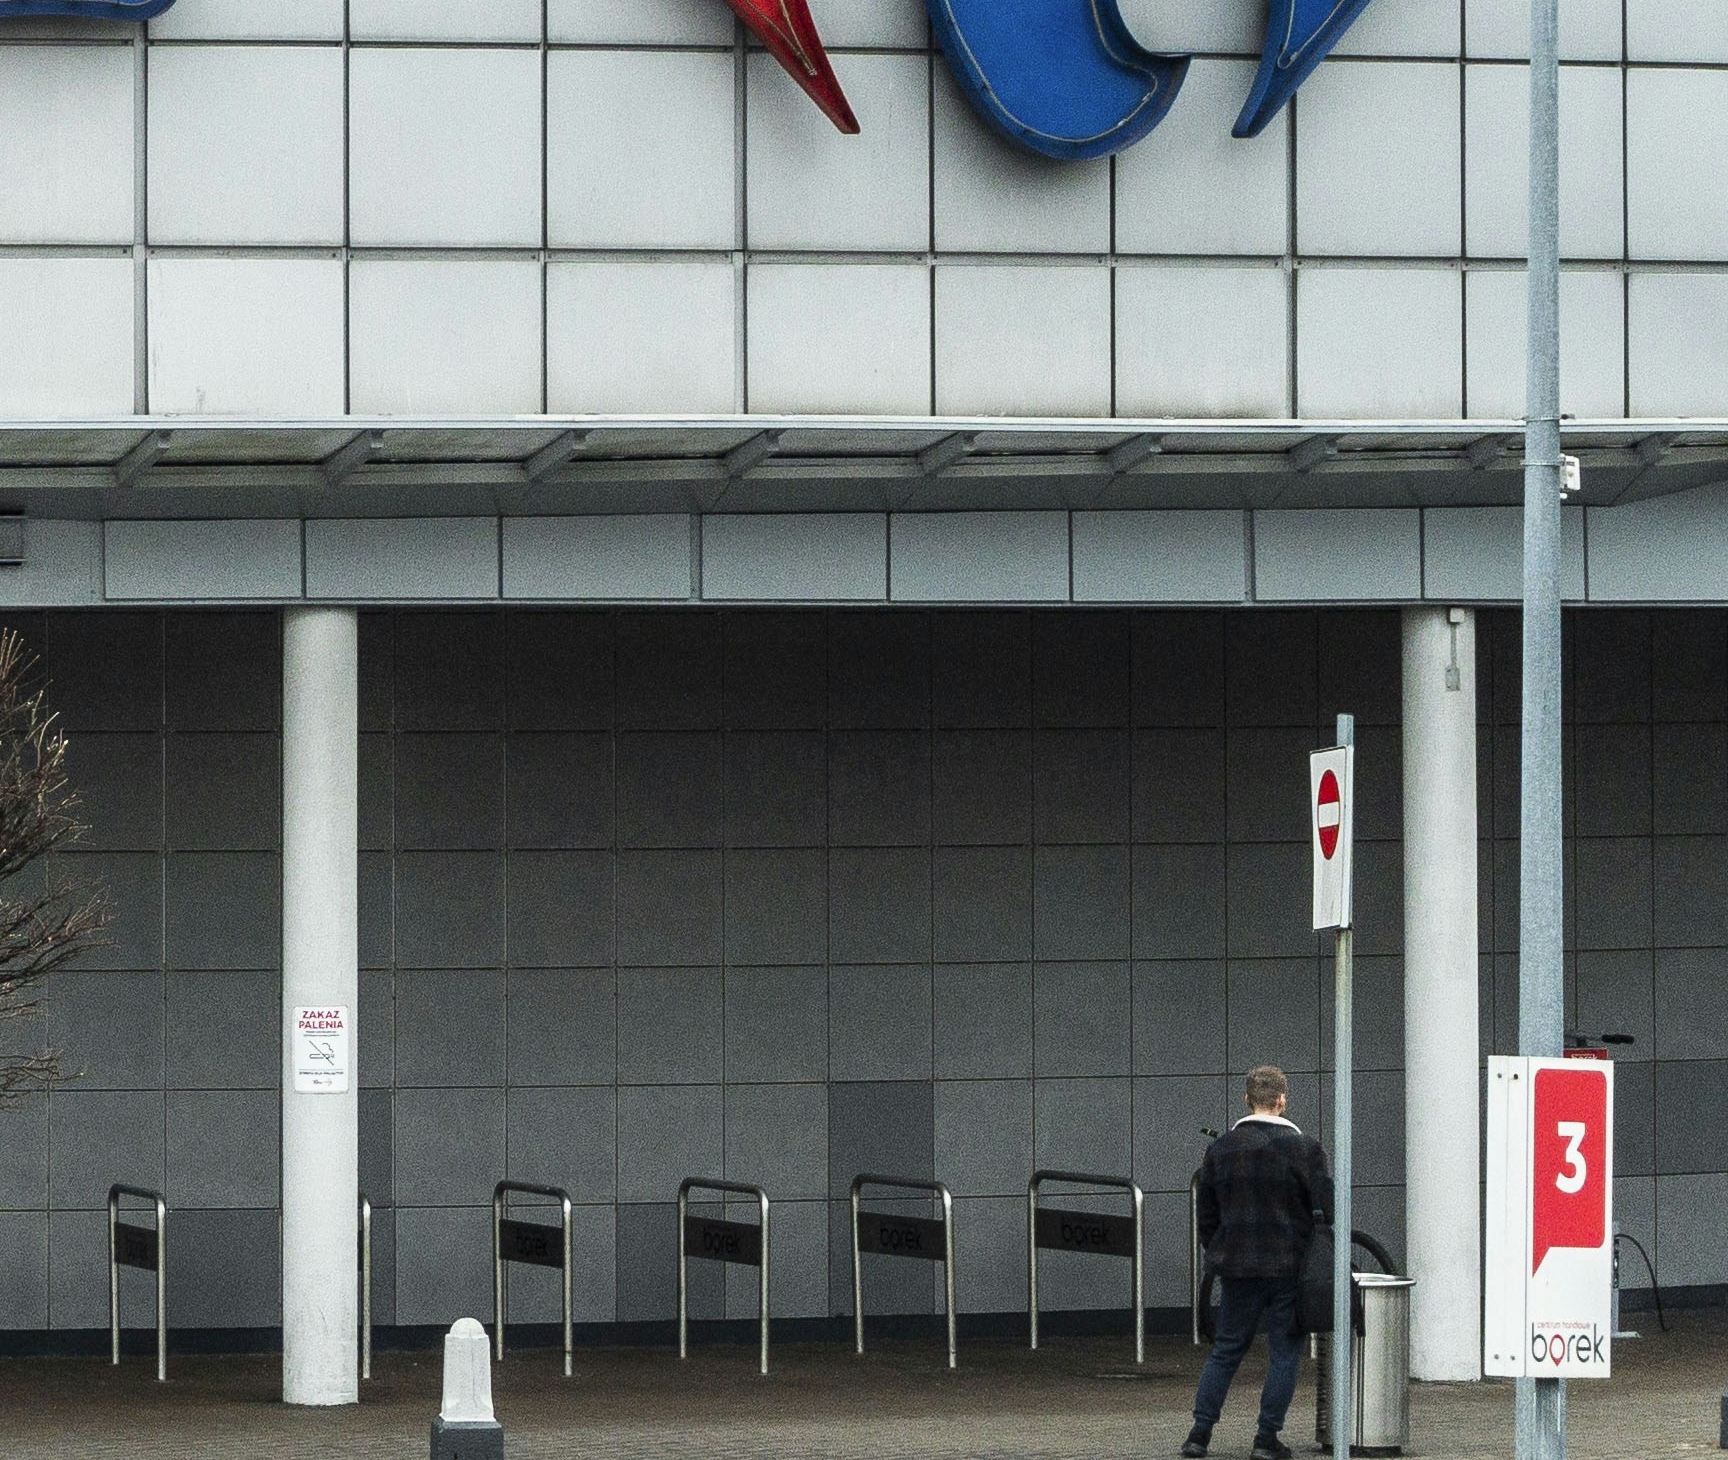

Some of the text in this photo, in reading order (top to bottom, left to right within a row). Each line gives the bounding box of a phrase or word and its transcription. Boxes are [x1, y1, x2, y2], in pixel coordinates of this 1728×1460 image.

[298, 1020, 344, 1029] PALENIA
[302, 1010, 340, 1019] ZAKAZ
[1555, 1121, 1587, 1194] 3
[703, 1224, 742, 1255] borek
[879, 1219, 923, 1251] borek
[1060, 1216, 1111, 1247] borek
[1531, 1322, 1605, 1367] borek
